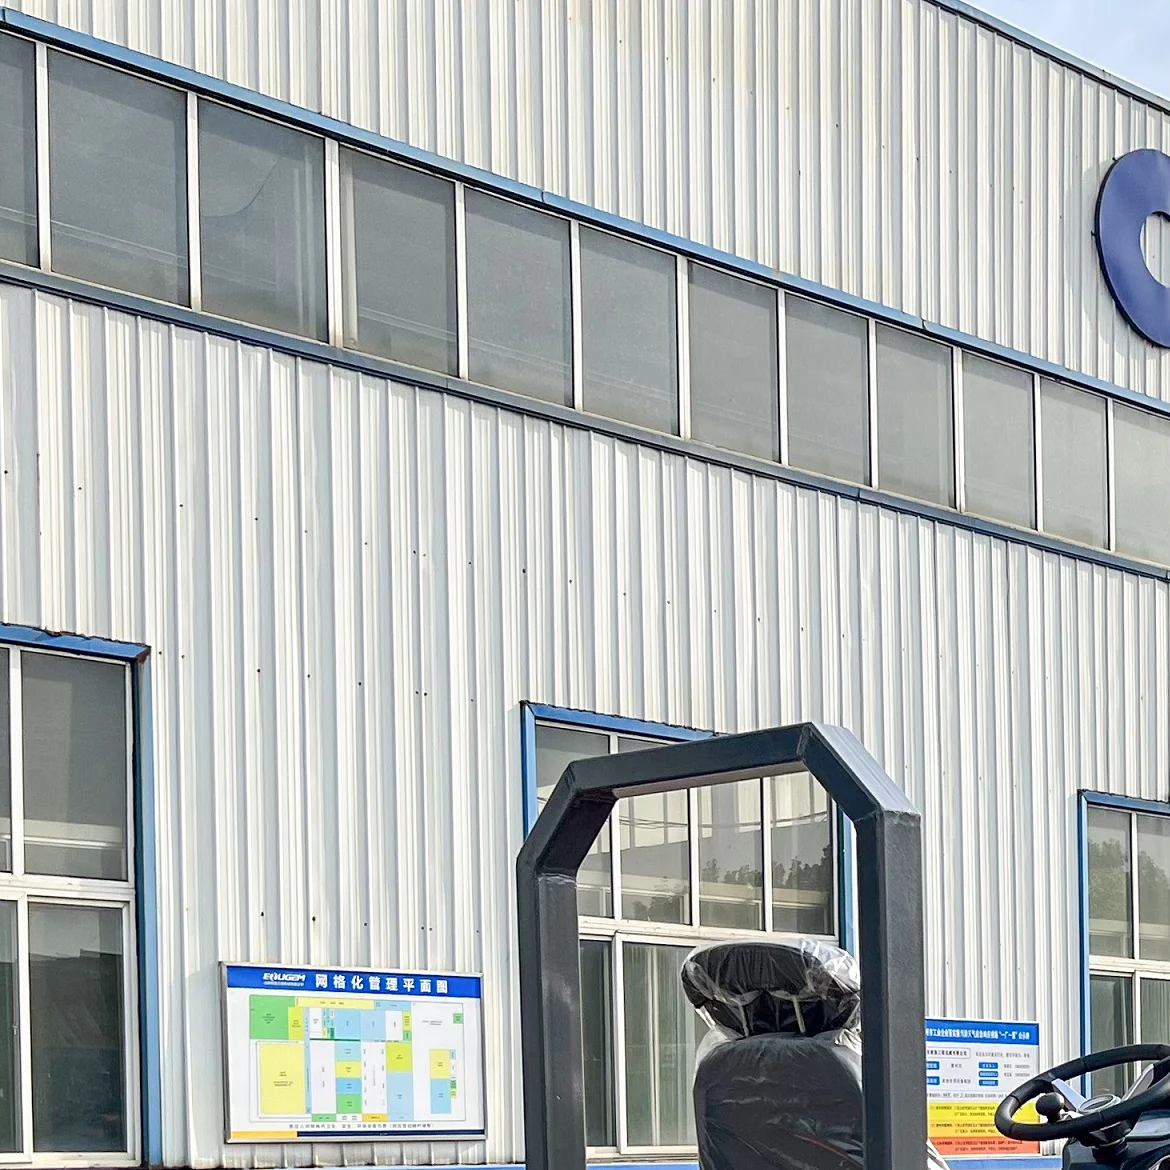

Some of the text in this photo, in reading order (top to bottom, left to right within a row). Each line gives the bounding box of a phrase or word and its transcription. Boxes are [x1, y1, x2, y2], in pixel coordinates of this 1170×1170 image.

[315, 973, 448, 994] 网格化管理平面图
